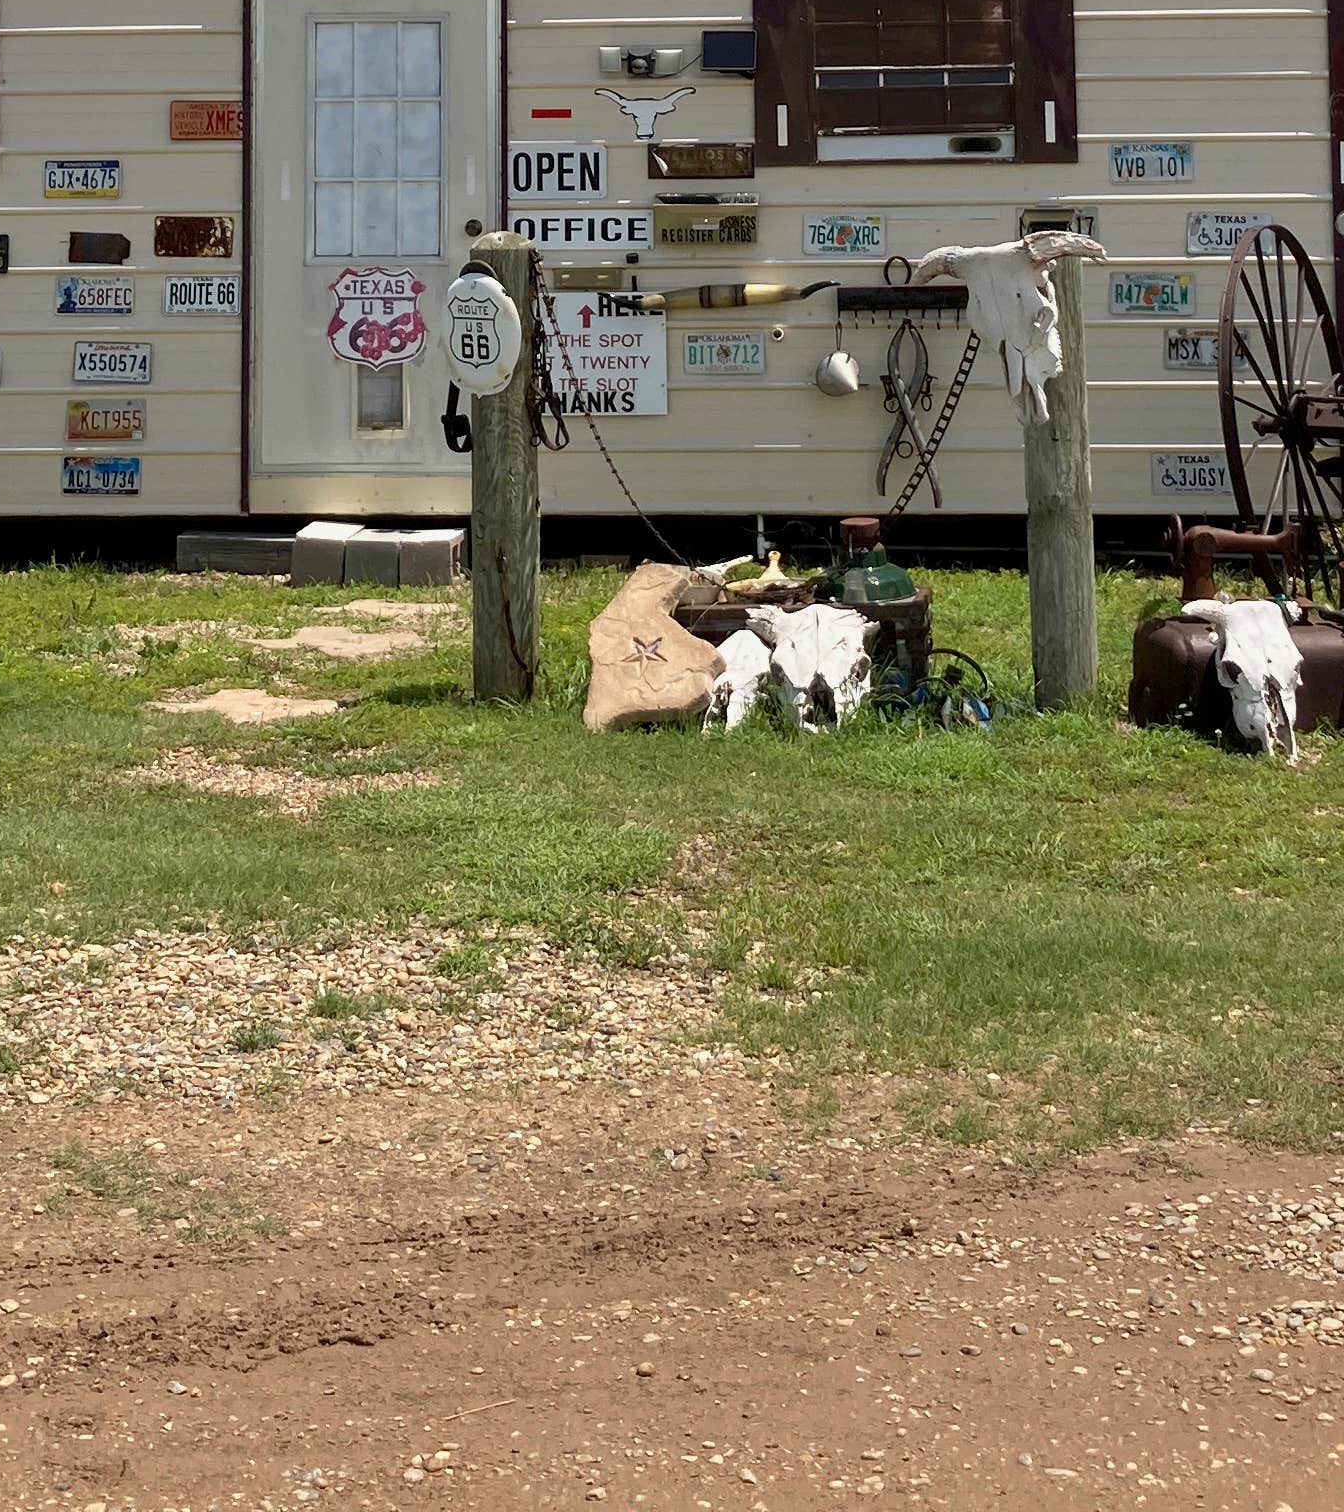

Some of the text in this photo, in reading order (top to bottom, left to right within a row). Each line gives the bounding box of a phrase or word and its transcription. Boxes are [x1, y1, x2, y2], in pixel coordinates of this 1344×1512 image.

[513, 152, 601, 192] OPEN
[1114, 157, 1185, 178] VVB 101
[514, 218, 649, 242] OFFICE
[1214, 215, 1247, 224] TEXAS
[661, 228, 753, 243] REGISTER CARDS
[808, 225, 881, 246] 764 XRC
[78, 288, 133, 306] 658FEC
[169, 282, 236, 306] ROUTE 66
[350, 279, 405, 295] TEXAS
[457, 304, 489, 316] ROUTE
[598, 295, 664, 317] HER
[461, 333, 490, 360] 66
[562, 334, 591, 347] THE
[598, 333, 644, 348] SPOT
[1167, 338, 1201, 361] MSX
[78, 352, 148, 373] X550574
[579, 355, 651, 369] TWENTY
[688, 344, 760, 365] BIT 712
[558, 377, 639, 392] THE SLOT
[537, 391, 635, 413] HANKS
[80, 409, 143, 430] KCT955
[1177, 455, 1211, 464] TEXAS
[1178, 468, 1226, 487] 3JGSY
